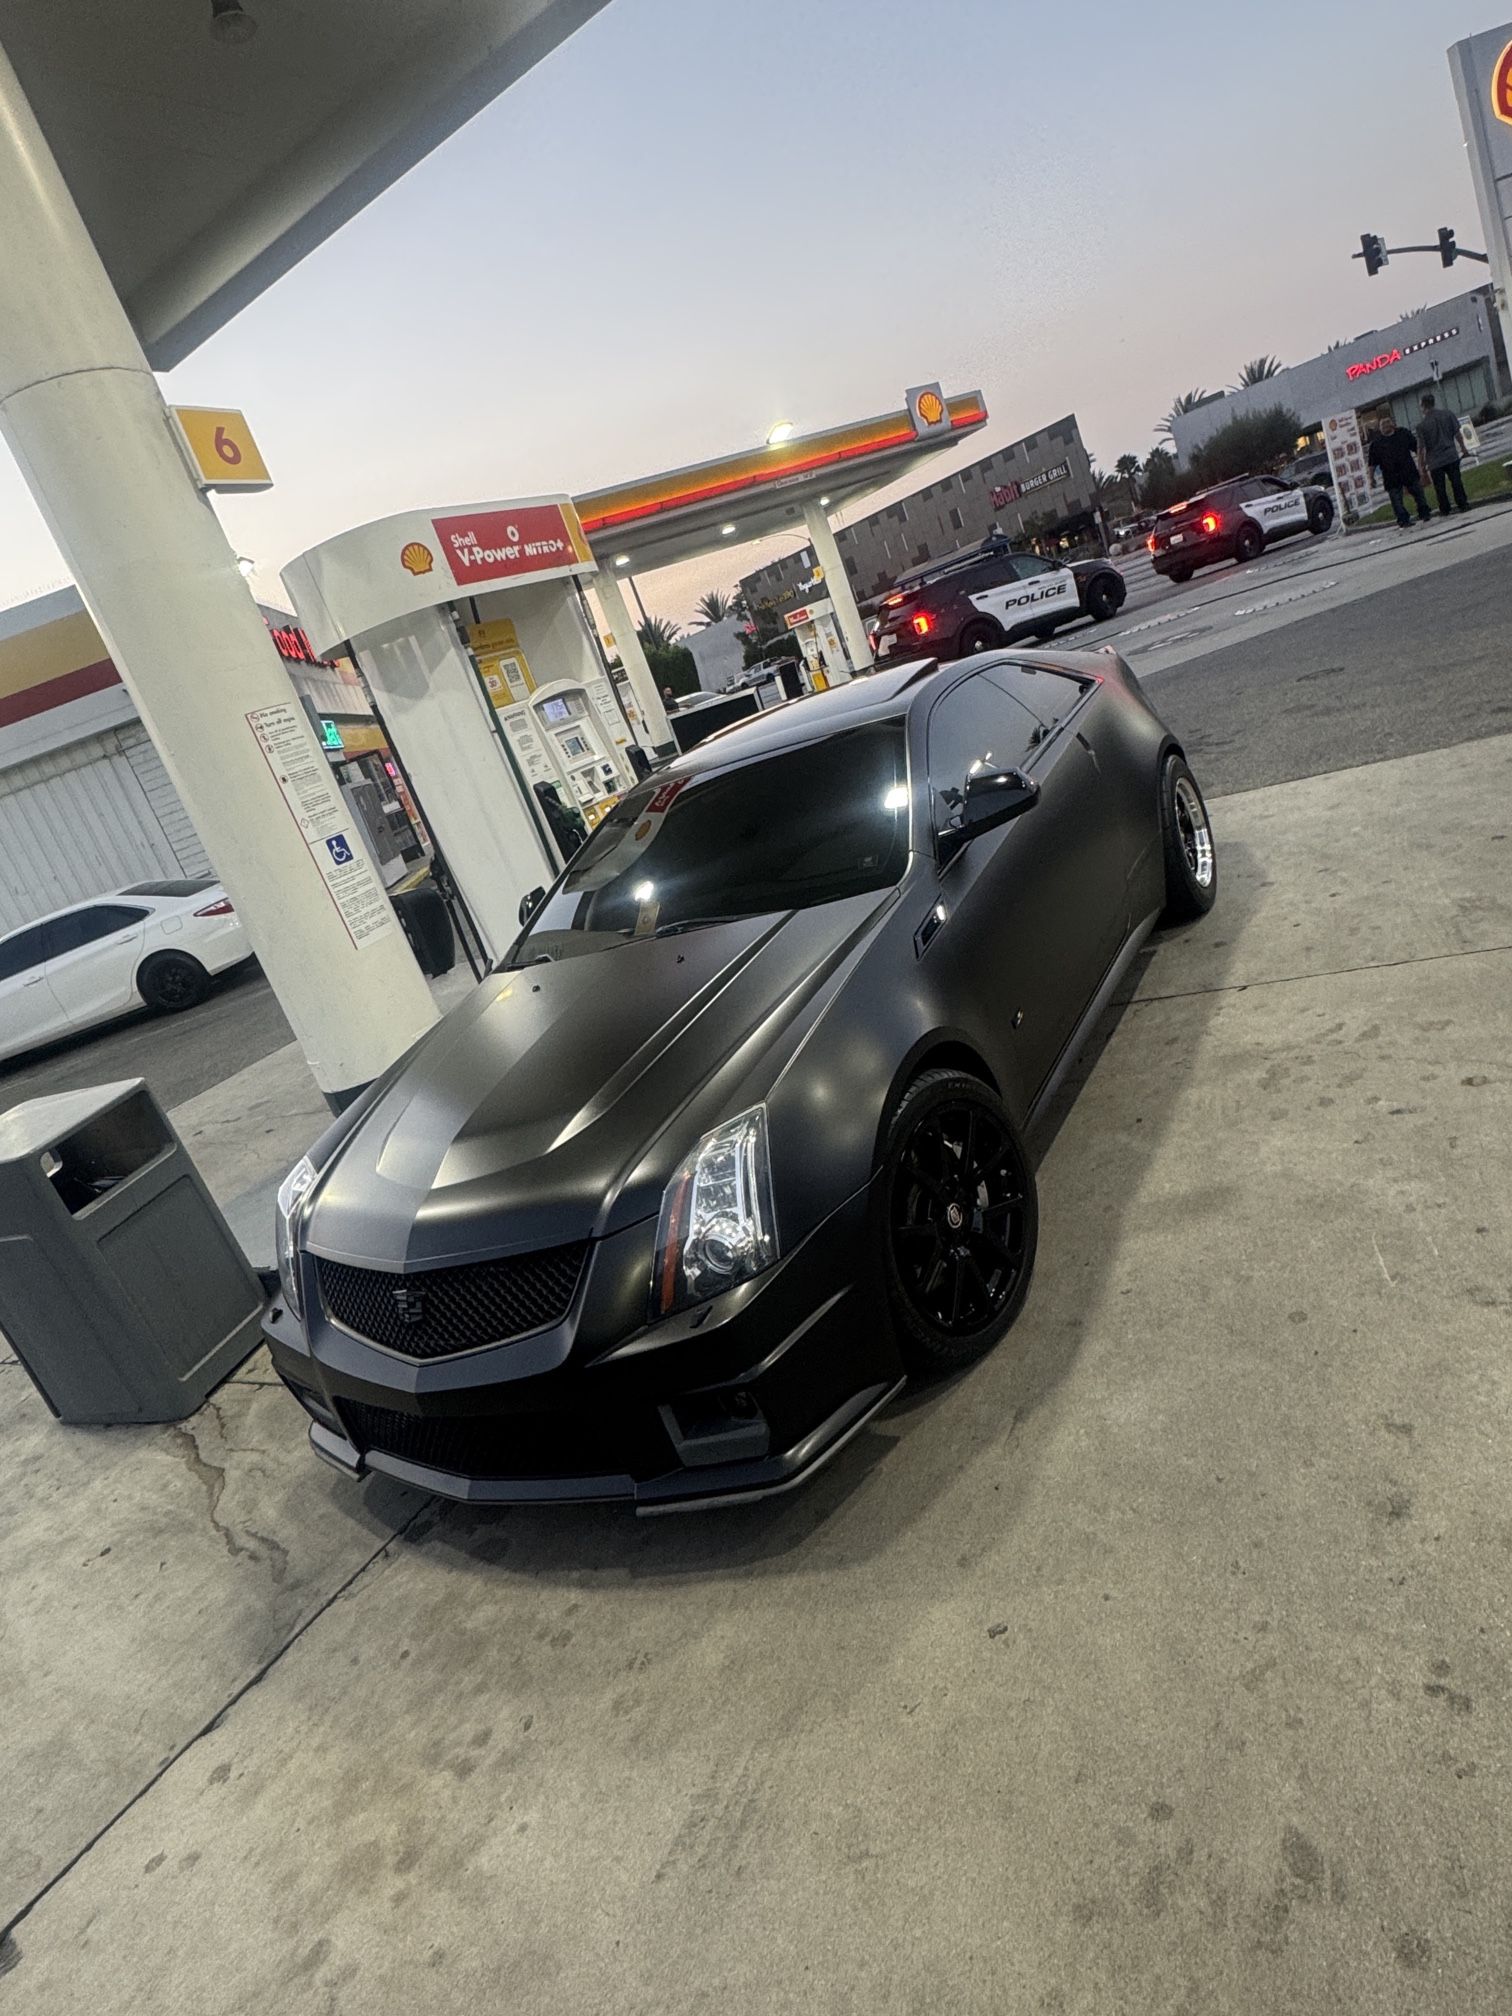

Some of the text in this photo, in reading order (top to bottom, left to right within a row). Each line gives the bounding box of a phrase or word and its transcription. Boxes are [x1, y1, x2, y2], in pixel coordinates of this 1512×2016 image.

[1345, 328, 1458, 380] PANDA EXPRESS
[214, 426, 242, 465] 6
[1020, 472, 1048, 493] BURGER
[1047, 464, 1067, 480] GRILL
[1264, 498, 1301, 516] POLICE
[450, 531, 478, 548] Shell
[455, 545, 522, 567] V-Power
[1005, 583, 1067, 610] POLICE
